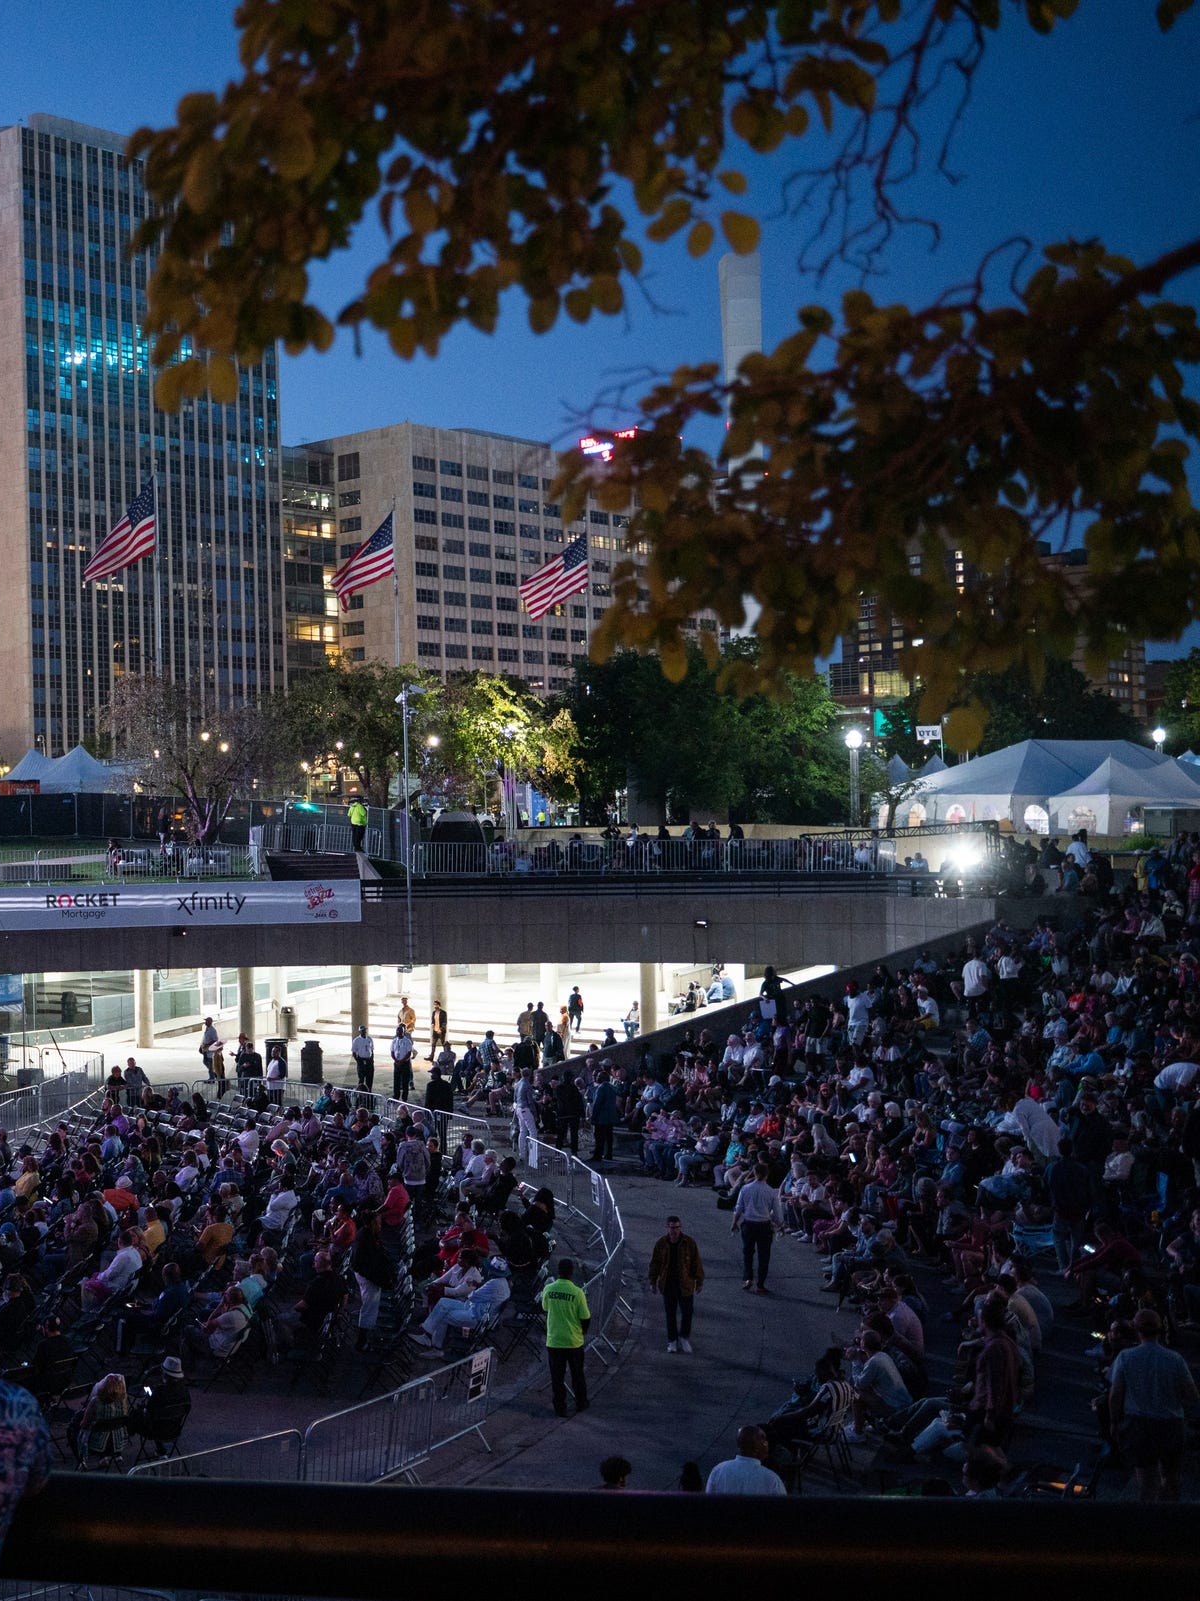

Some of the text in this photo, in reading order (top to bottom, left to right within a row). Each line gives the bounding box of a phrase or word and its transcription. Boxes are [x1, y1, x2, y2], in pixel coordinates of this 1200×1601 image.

[46, 893, 120, 908] ROCKET
[176, 891, 247, 916] xfinity
[61, 909, 106, 920] Mortgage
[548, 1291, 576, 1302] SECURITY
